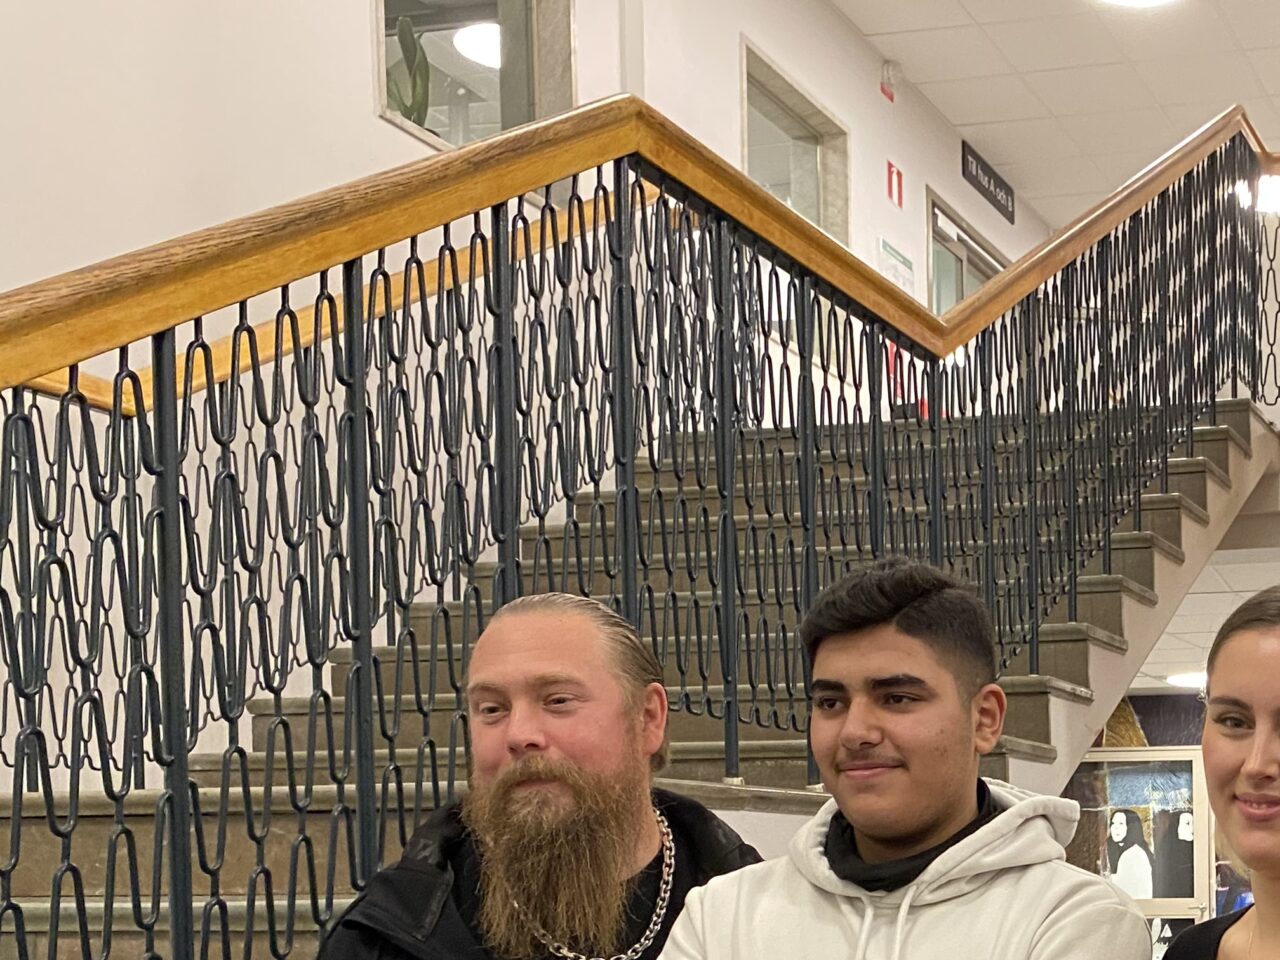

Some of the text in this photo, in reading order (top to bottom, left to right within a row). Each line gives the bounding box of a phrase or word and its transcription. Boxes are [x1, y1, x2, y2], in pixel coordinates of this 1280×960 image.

[977, 164, 989, 190] hus
[989, 178, 996, 197] A
[996, 187, 1008, 208] och
